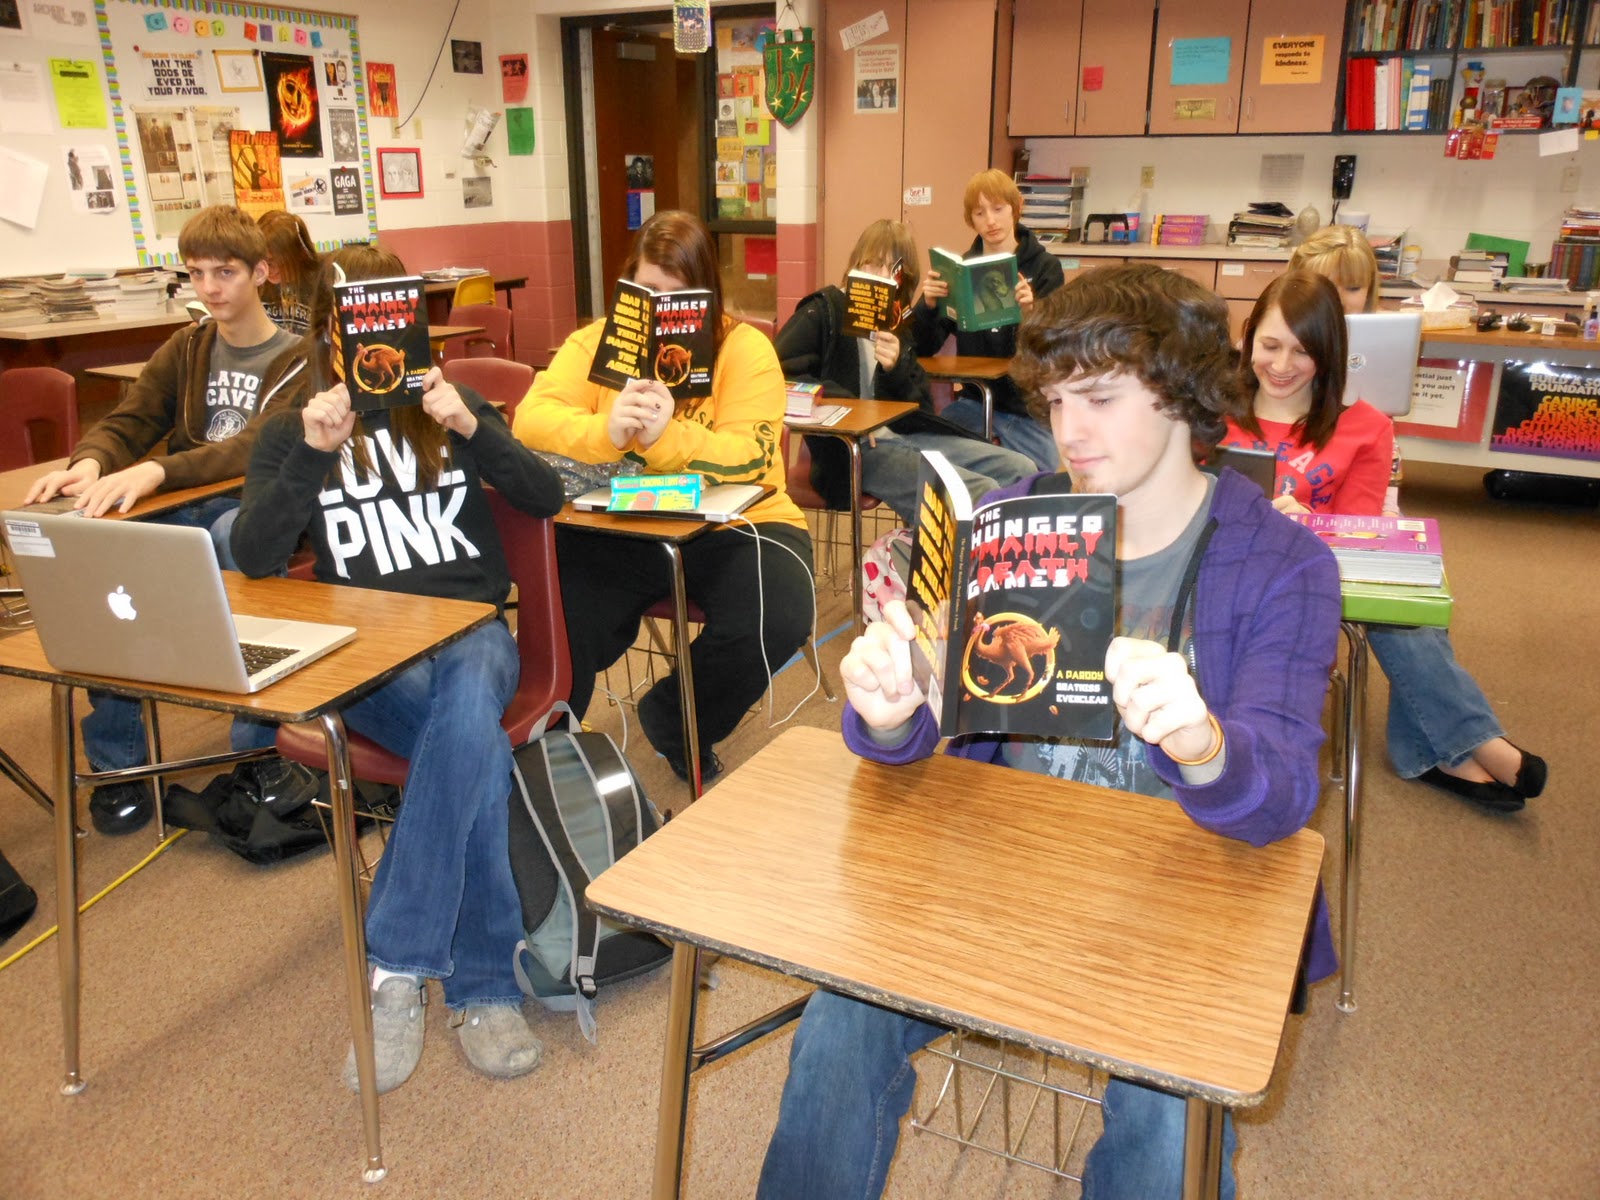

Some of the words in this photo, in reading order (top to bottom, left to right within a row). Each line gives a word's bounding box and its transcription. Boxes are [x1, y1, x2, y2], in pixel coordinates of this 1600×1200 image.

[1273, 41, 1315, 49] EVERYONE
[152, 59, 170, 68] MAY
[174, 60, 193, 68] THE
[154, 68, 179, 77] ODDS
[184, 78, 195, 86] IN
[148, 87, 173, 95] YOUR
[334, 175, 356, 188] GAGA
[348, 286, 364, 294] THE
[342, 289, 418, 306] HUNGER
[353, 296, 419, 315] MAINLY
[656, 301, 707, 312] HUNGER
[1529, 373, 1568, 384] BUILD
[1571, 376, 1582, 386] A
[206, 388, 257, 410] CAVE
[1542, 395, 1598, 407] CARING
[980, 507, 1001, 525] THE
[324, 486, 481, 579] PINK
[972, 515, 1102, 551] HUNGER
[979, 530, 1104, 562] MAINLY
[977, 557, 1088, 591] DEATH
[967, 569, 1071, 600] GAMES
[1056, 670, 1064, 679] A
[1066, 670, 1104, 680] PARODY
